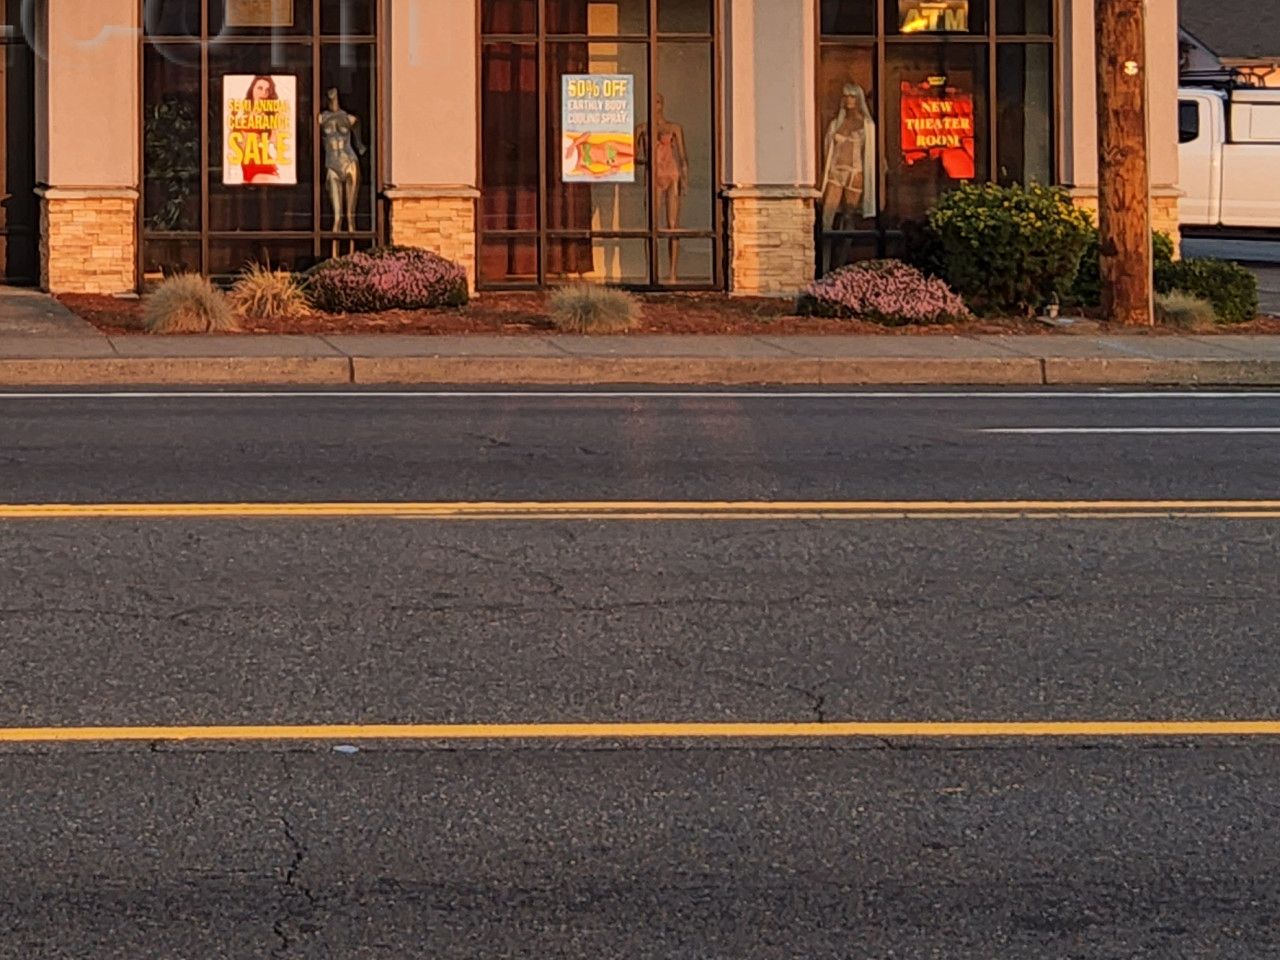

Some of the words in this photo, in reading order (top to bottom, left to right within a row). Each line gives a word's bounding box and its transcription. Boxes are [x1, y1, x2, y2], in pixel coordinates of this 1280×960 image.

[903, 8, 966, 31] ATM
[568, 79, 600, 97] 50%
[603, 79, 628, 97] OFF
[921, 101, 953, 112] NEW
[906, 119, 969, 130] THEATER
[228, 132, 291, 165] SALE
[916, 135, 960, 147] ROOM
